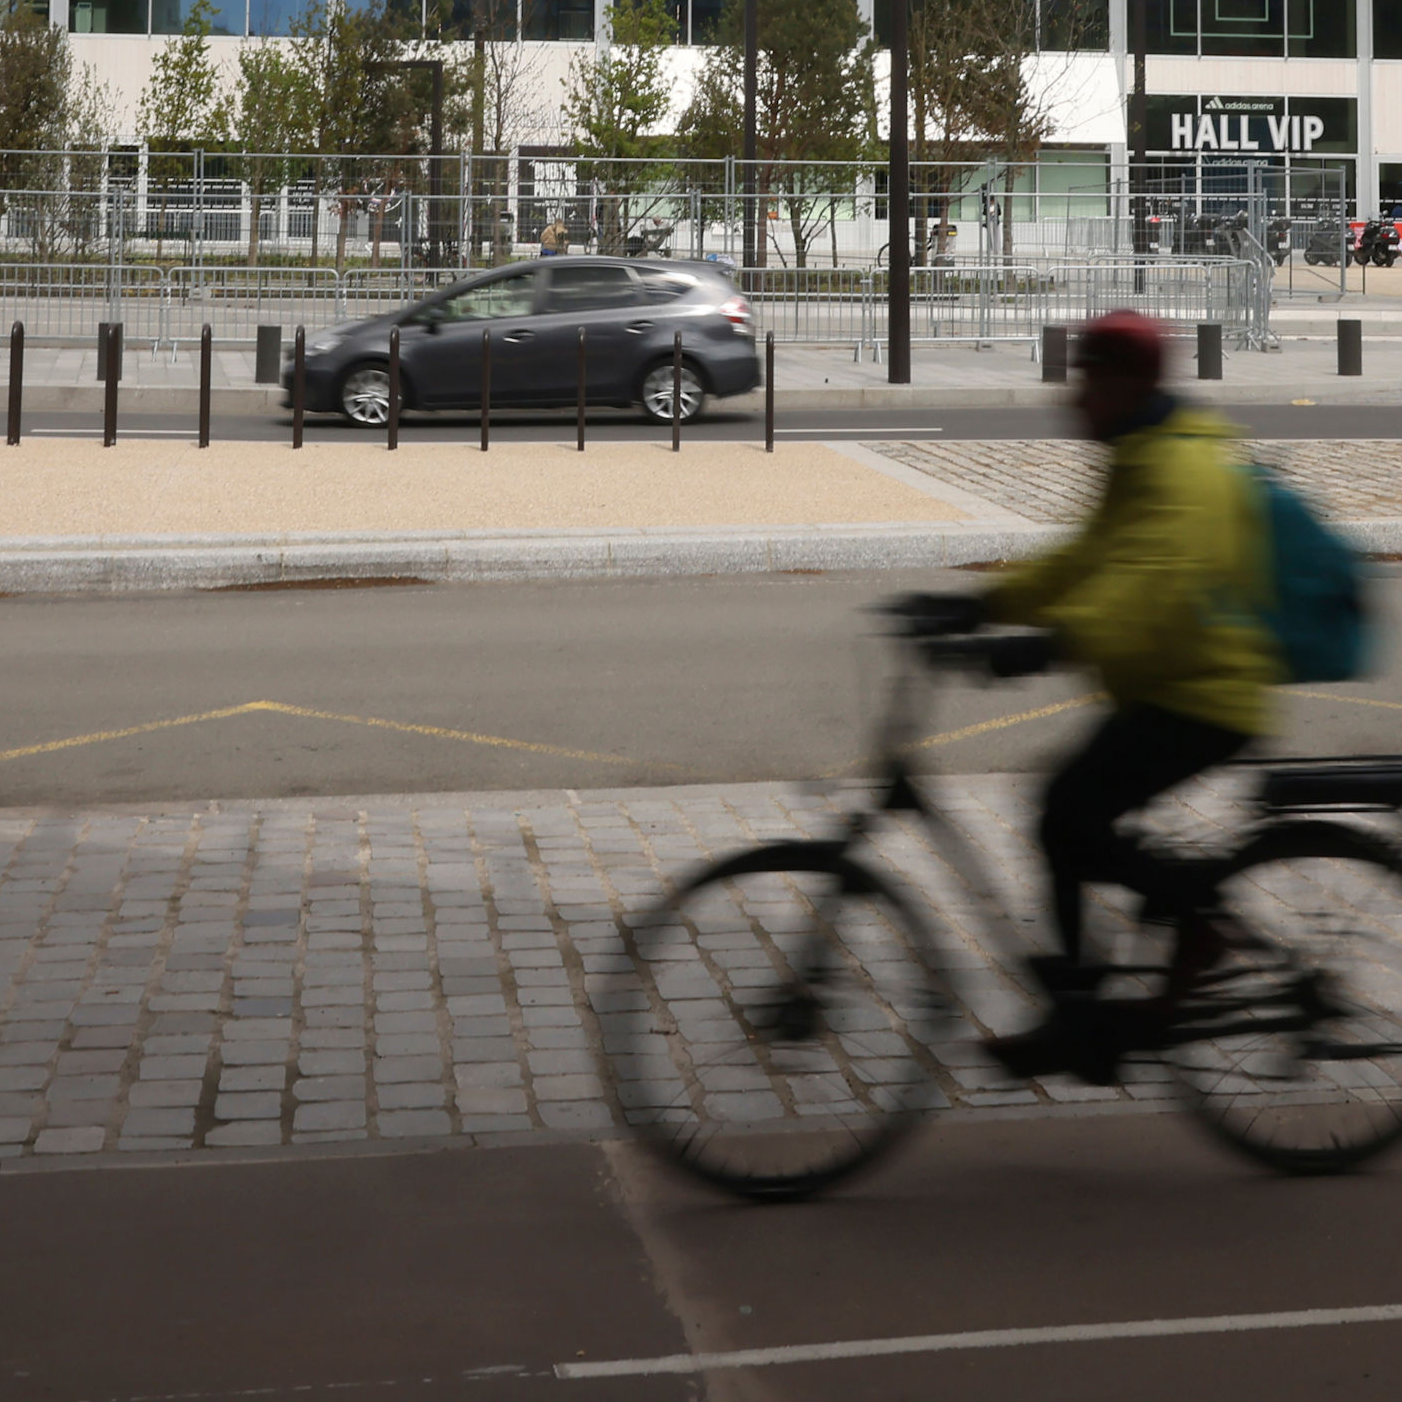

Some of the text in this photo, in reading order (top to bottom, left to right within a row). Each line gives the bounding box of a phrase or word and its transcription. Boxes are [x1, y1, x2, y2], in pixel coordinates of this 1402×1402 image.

[1224, 100, 1274, 111] adidas arena
[1171, 113, 1325, 151] HALL VIP
